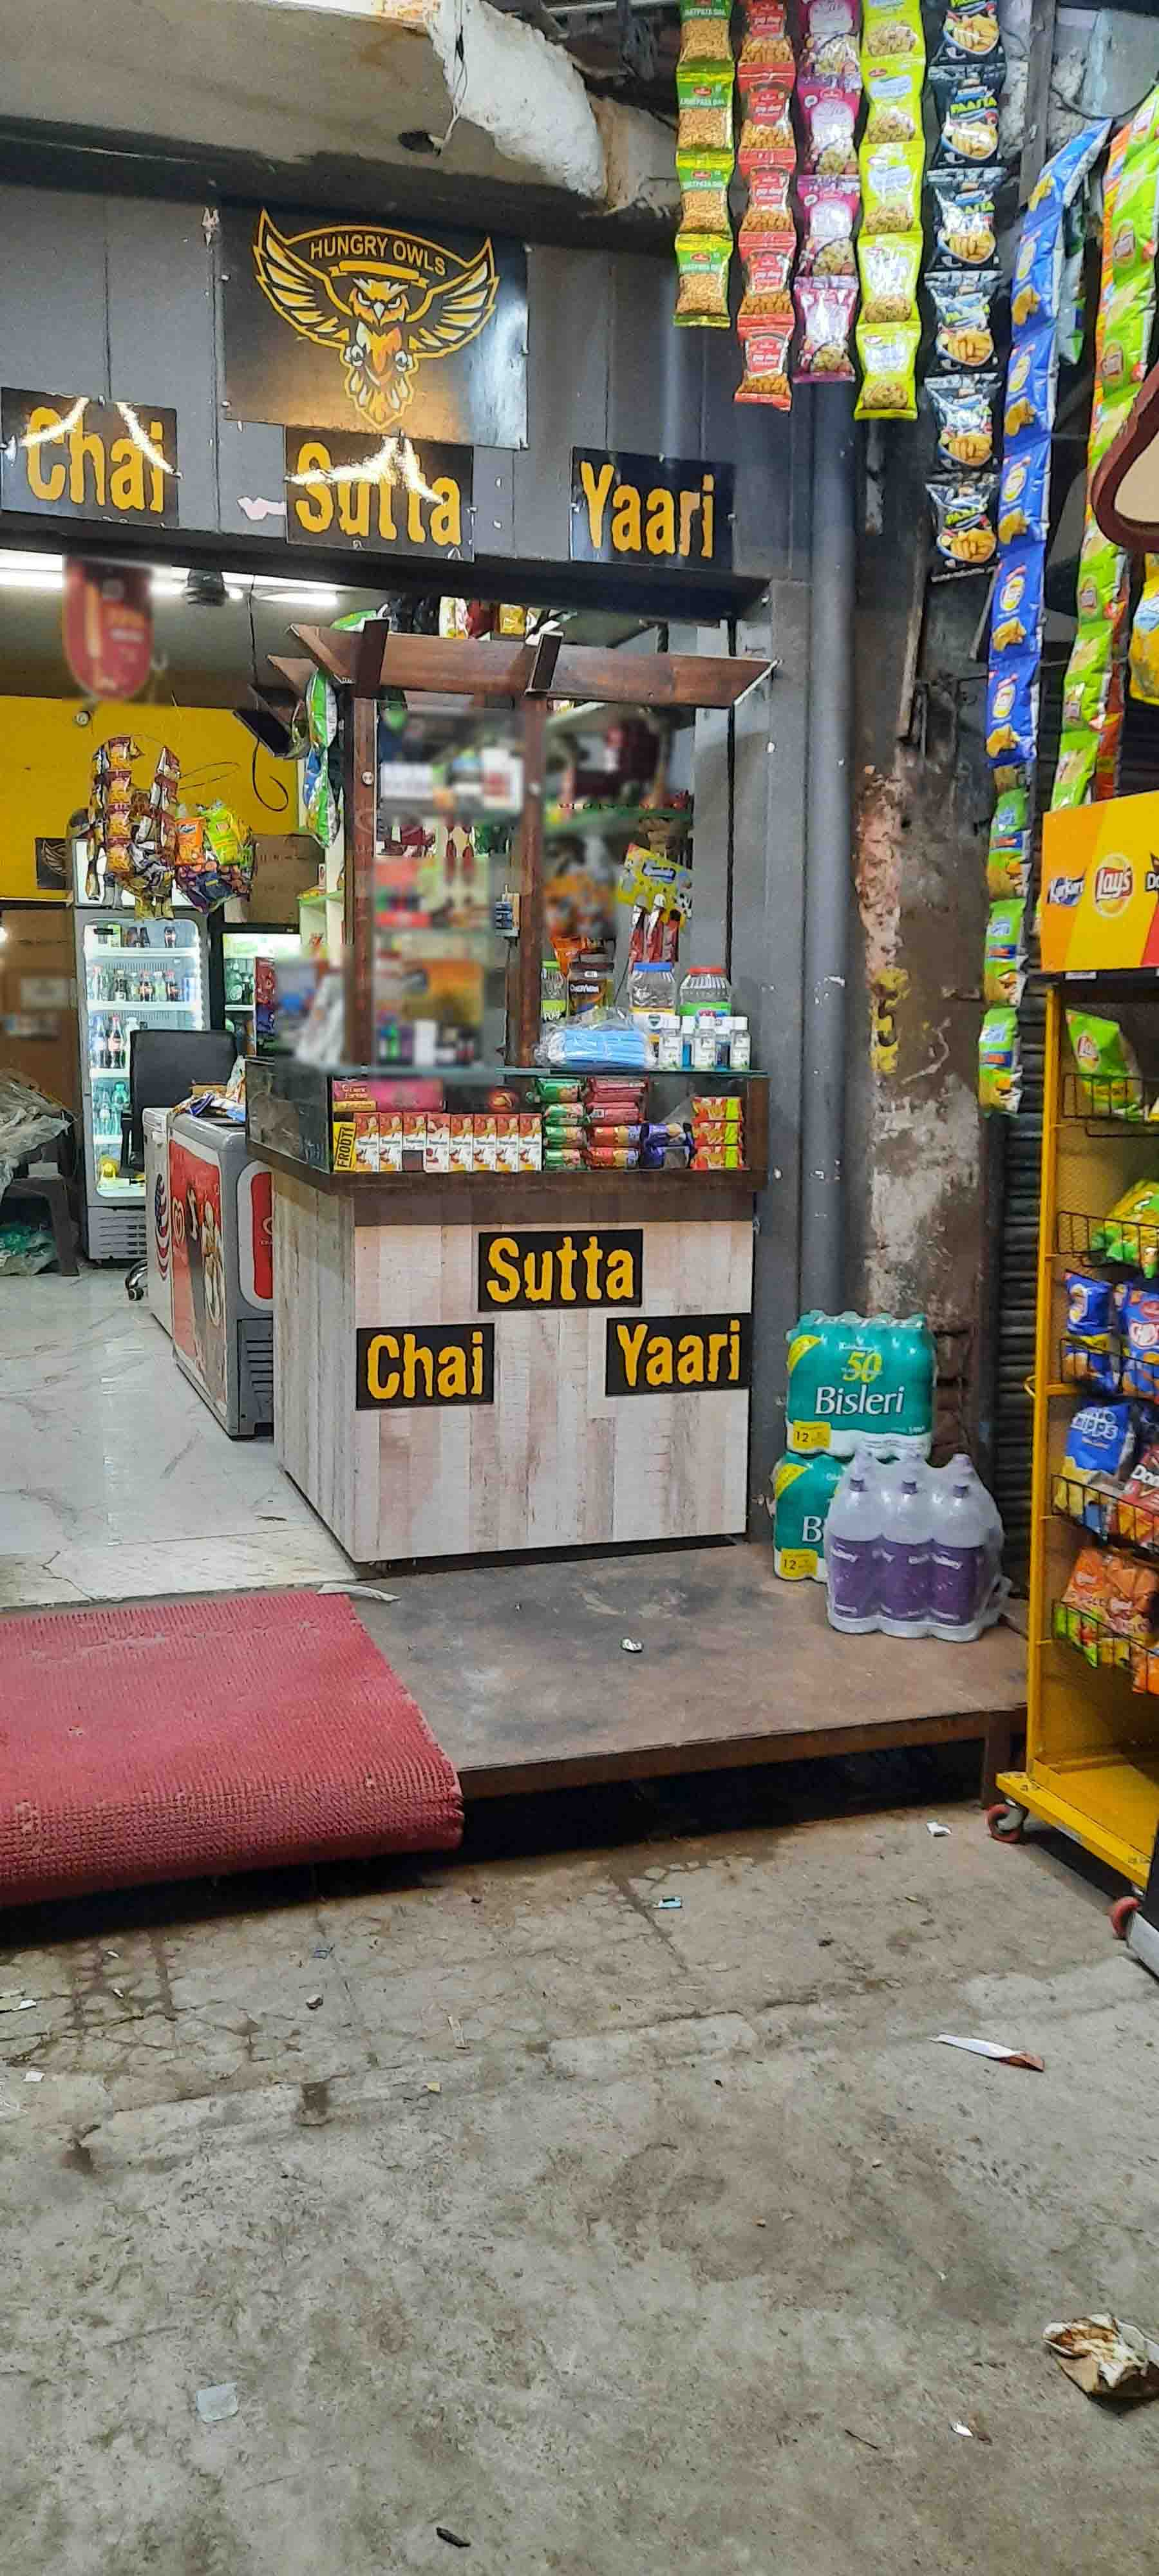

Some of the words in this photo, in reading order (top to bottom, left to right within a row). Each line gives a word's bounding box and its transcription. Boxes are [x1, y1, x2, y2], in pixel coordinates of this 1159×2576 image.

[310, 234, 388, 260] HUNGRY
[393, 240, 446, 276] OWLS
[26, 406, 164, 514] Chai
[295, 441, 462, 547] Sutta
[580, 462, 714, 558] Yaari
[1096, 867, 1133, 900] Lay's
[487, 1236, 634, 1303] Sutta
[367, 1331, 483, 1399] Chai
[617, 1320, 740, 1387] Yaari
[843, 1351, 882, 1382] 50
[815, 1384, 904, 1414] Bisleri
[796, 1431, 809, 1442] 12
[783, 1558, 797, 1570] 12
